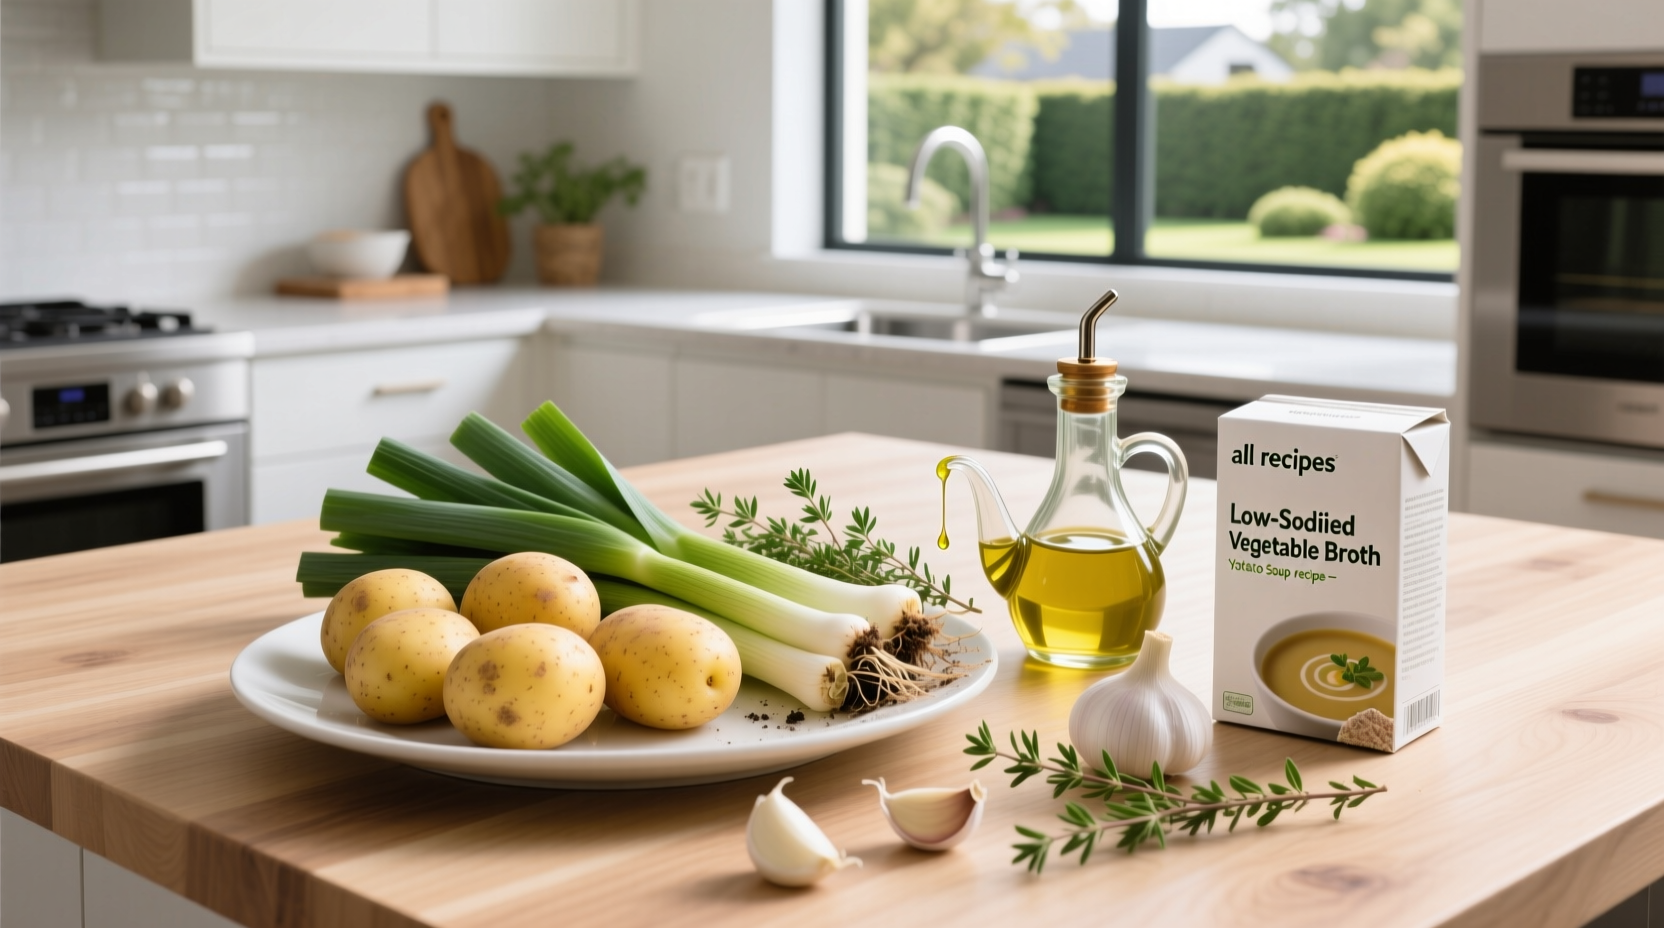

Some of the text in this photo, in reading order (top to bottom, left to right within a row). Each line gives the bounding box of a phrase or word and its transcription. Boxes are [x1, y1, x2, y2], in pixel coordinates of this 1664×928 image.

[1231, 444, 1336, 476] all recipes
[1229, 530, 1381, 566] Vegetable Broth
[1266, 564, 1291, 581] Soup
[1294, 569, 1326, 584] recipe
